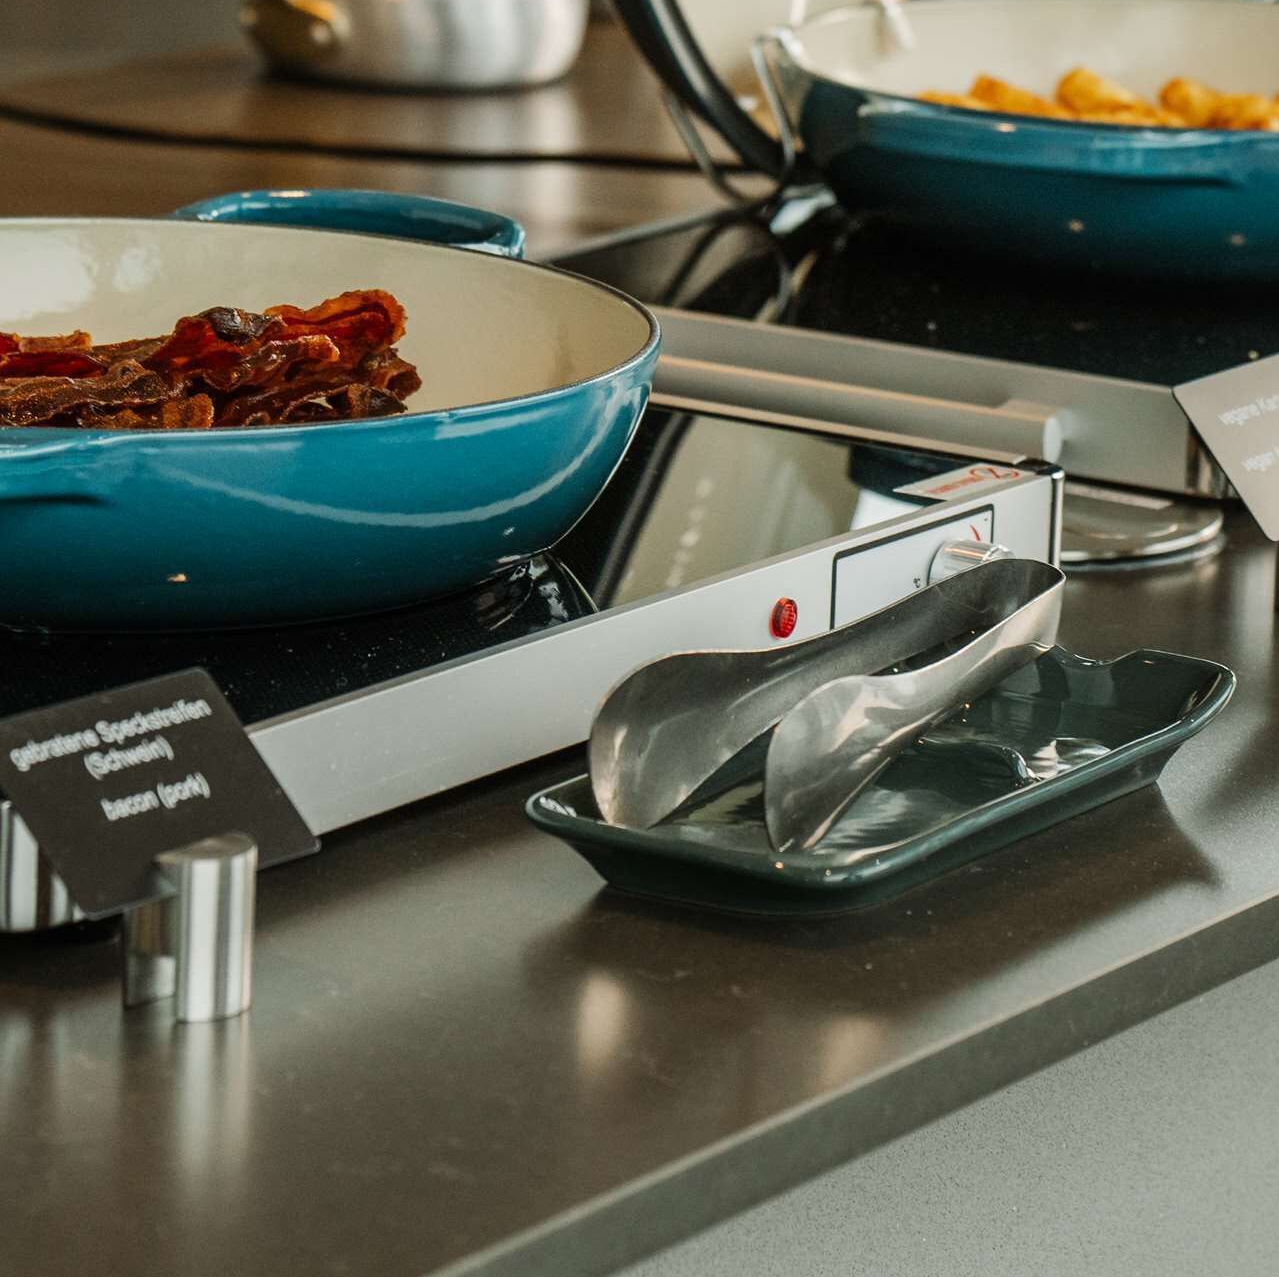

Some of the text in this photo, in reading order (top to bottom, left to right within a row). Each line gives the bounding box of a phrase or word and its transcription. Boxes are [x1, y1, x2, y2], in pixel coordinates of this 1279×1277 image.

[9, 698, 213, 772] gebratene Speckstreifen
[83, 734, 175, 781] (Schwein)
[100, 771, 211, 822] bacon (pork)
